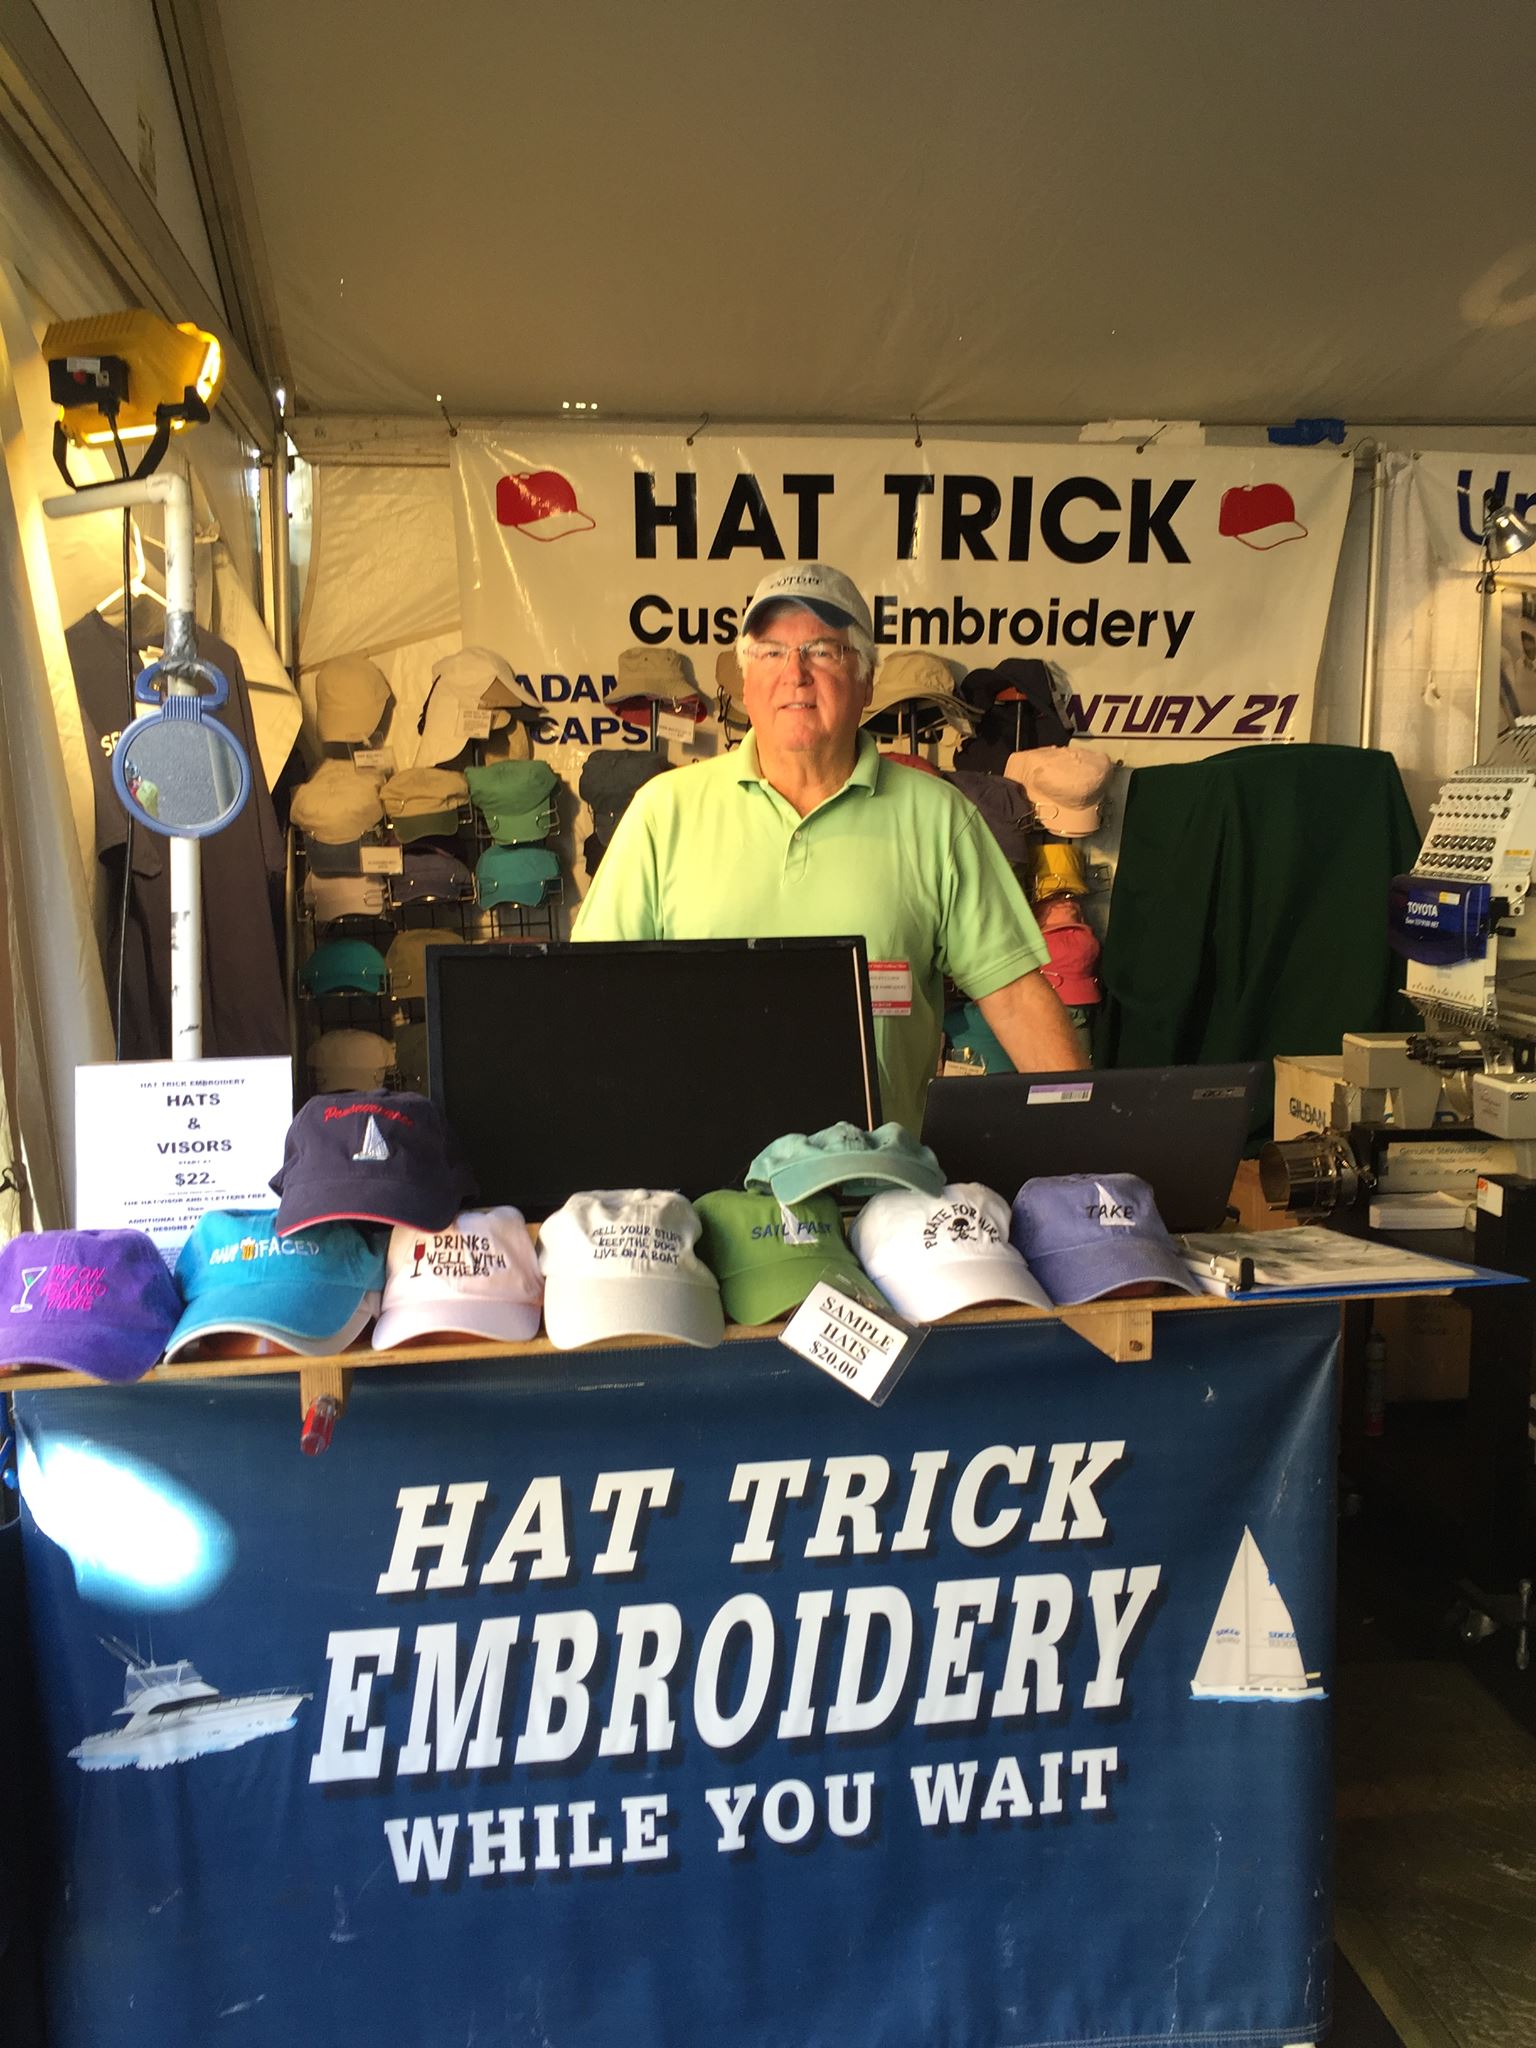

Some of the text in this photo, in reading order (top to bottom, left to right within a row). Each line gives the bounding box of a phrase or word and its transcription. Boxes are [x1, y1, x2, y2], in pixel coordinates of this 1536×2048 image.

[634, 472, 1197, 564] HAT TRICK
[873, 595, 1196, 659] Embroidery
[1232, 694, 1299, 734] 21
[530, 717, 648, 745] CAPS
[1407, 901, 1438, 917] TOYOTA
[190, 1078, 246, 1087] EMBROIDERY
[167, 1093, 221, 1107] HATS
[187, 1117, 201, 1130] &
[157, 1139, 232, 1155] VISORS
[175, 1172, 216, 1187] $22.
[1085, 1204, 1135, 1219] TAKE
[620, 1224, 650, 1236] YOUR
[752, 1223, 789, 1241] SAIL
[923, 1208, 952, 1250] PIRATE
[951, 1203, 977, 1219] FOR
[434, 1234, 490, 1251] DRINKS
[427, 1252, 507, 1269] WELL WITH
[593, 1247, 679, 1265] LIVE ON A BOAT
[79, 1266, 106, 1281] ON
[433, 1264, 490, 1277] OTHERS
[822, 1296, 894, 1352] SAMPLE
[823, 1322, 870, 1362] HATS
[809, 1339, 858, 1380] $20.00
[376, 1440, 1126, 1594] HAT TRICK
[308, 1564, 1162, 1785] EMBROIDERY
[384, 1746, 1119, 1884] WHILE YOU WAIT
